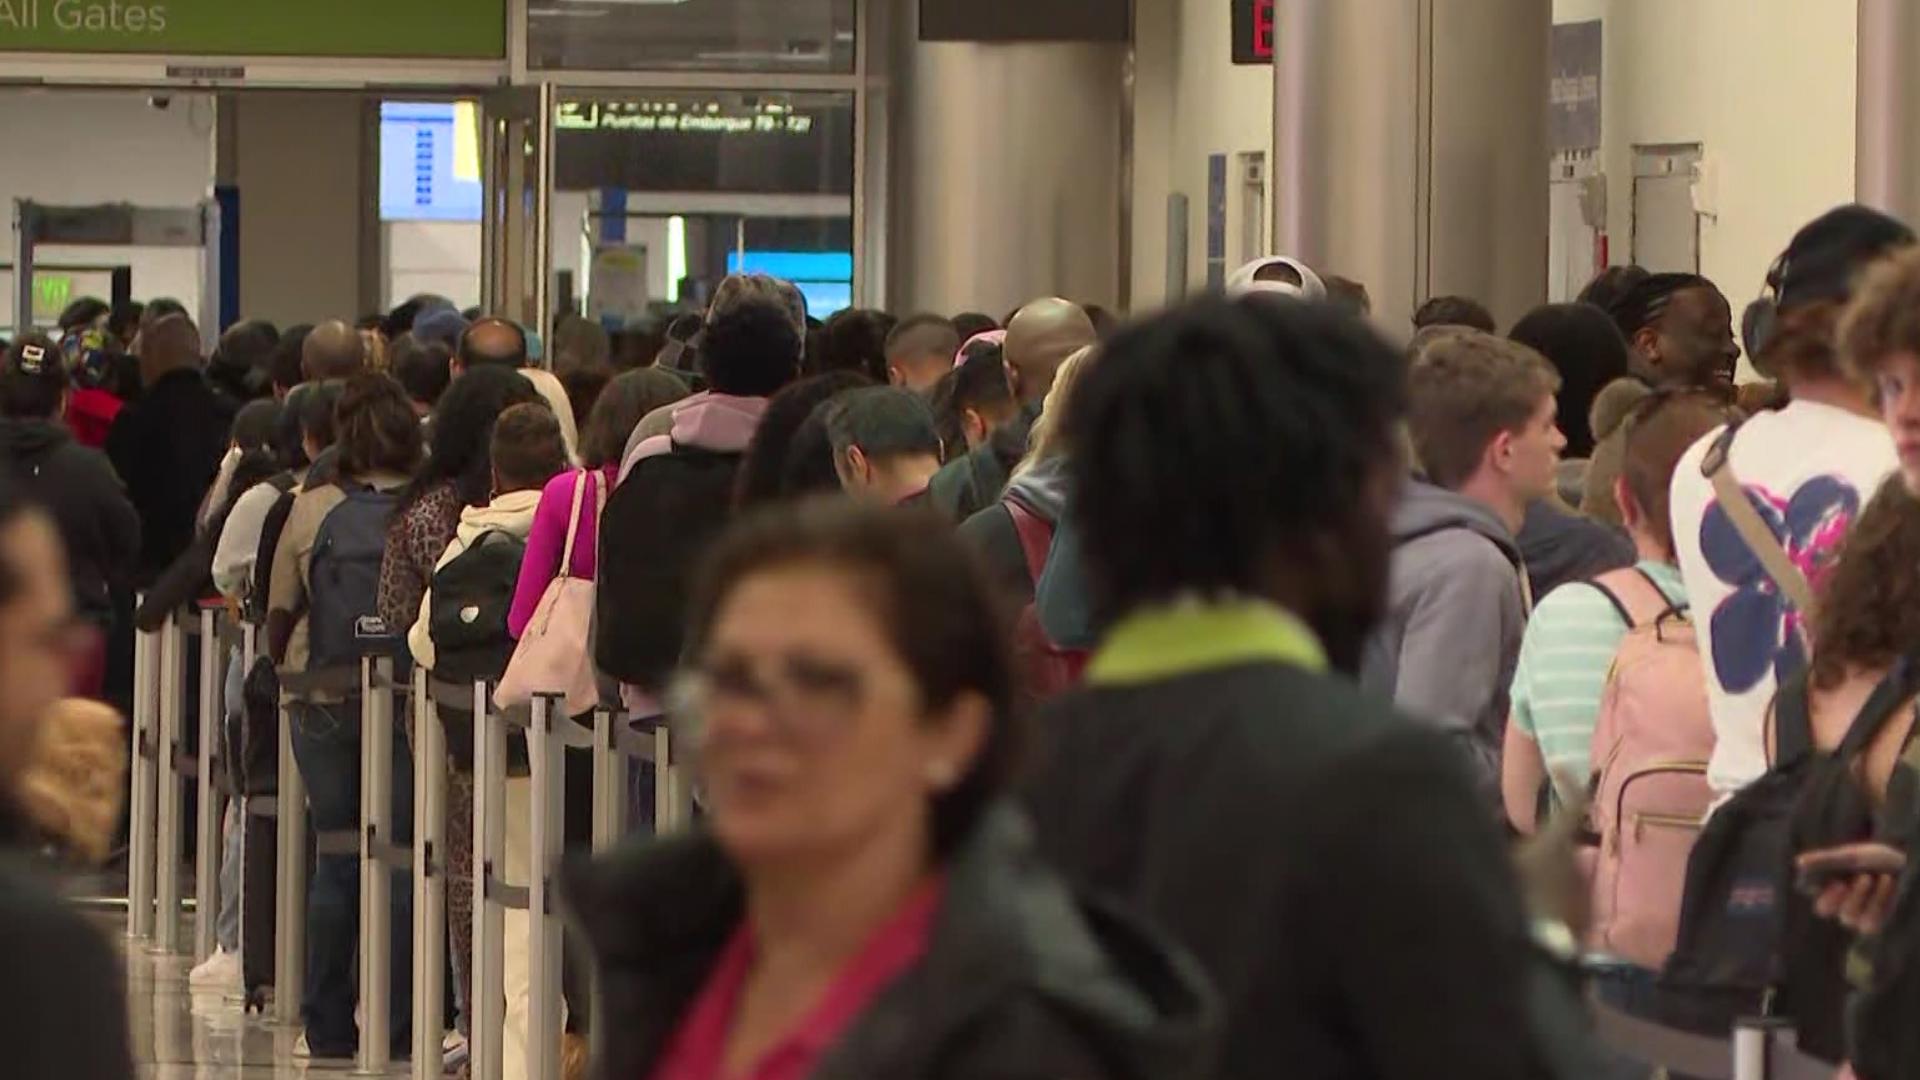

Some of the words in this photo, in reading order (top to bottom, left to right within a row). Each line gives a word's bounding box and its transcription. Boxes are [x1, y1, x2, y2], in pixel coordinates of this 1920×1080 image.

[53, 0, 166, 31] Gates
[601, 113, 655, 130] Puertas
[657, 115, 678, 130] de
[680, 114, 752, 134] Embarque
